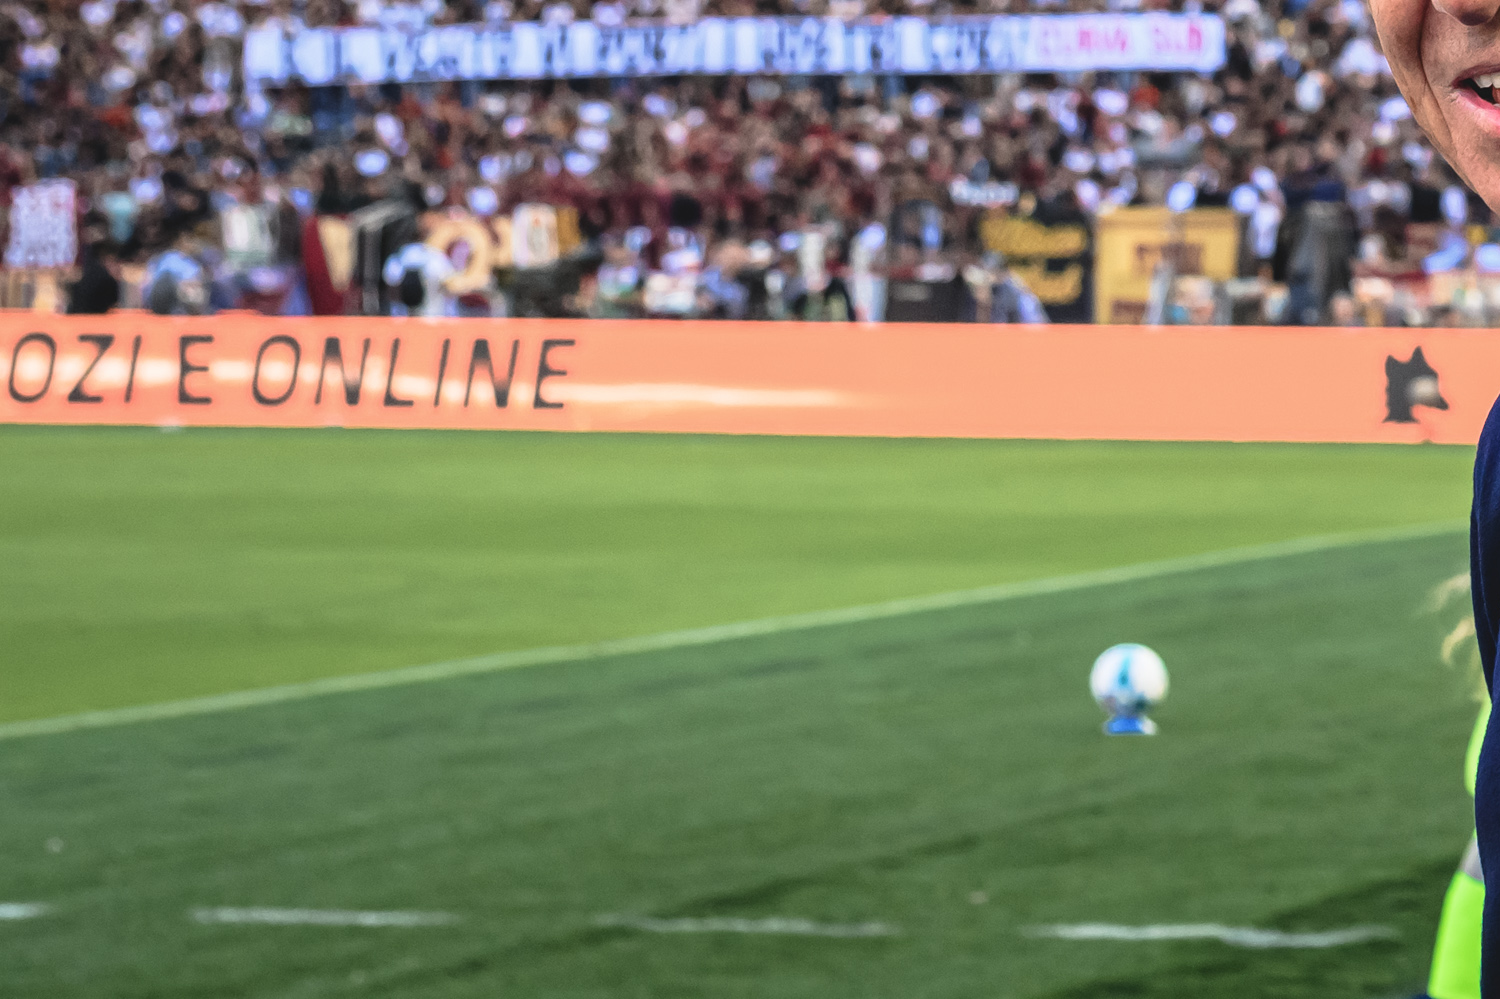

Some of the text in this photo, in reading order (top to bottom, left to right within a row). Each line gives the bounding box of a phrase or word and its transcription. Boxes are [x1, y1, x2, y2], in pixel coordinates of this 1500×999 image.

[7, 332, 576, 410] OZI E ONLINE
